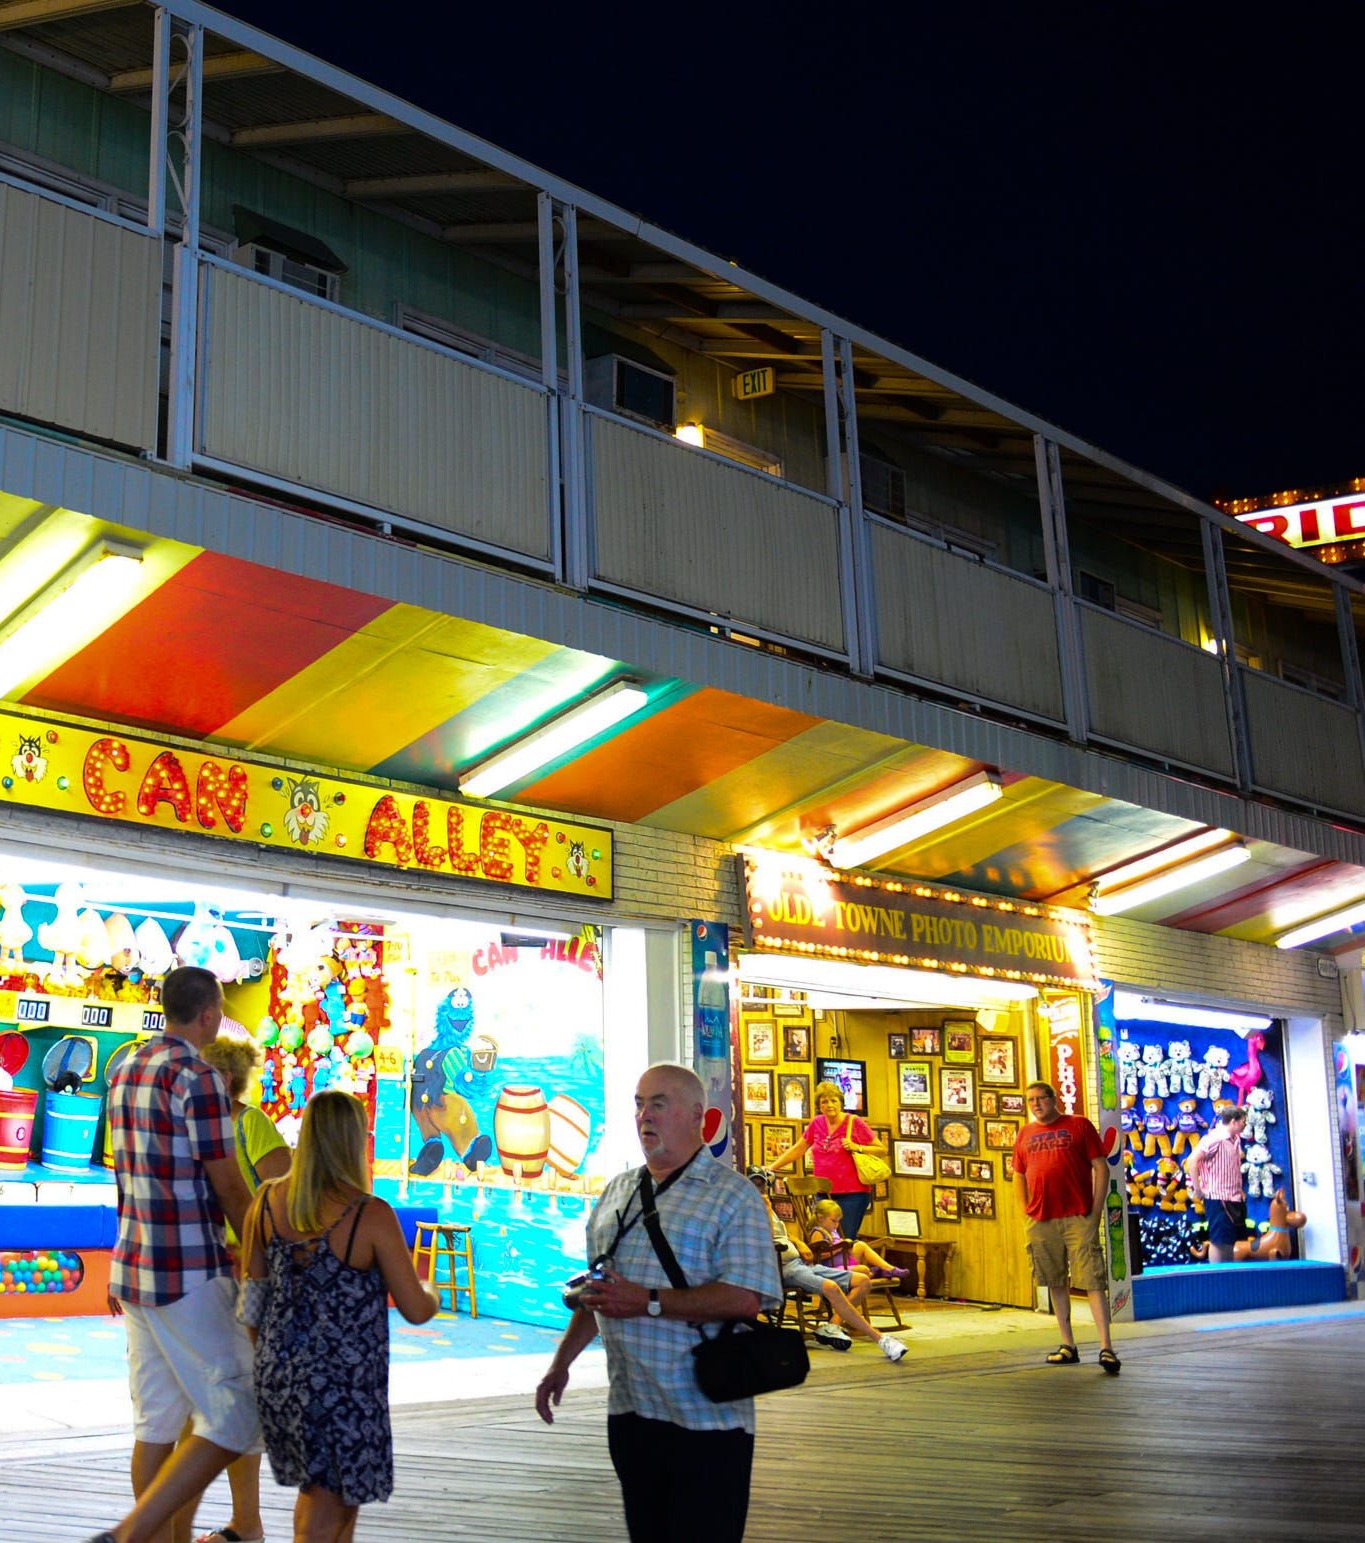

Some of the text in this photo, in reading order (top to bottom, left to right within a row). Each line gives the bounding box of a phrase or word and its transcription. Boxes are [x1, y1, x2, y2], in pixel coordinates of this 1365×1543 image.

[742, 369, 767, 396] EXIT
[82, 737, 550, 883] CAN ALLEY
[835, 899, 907, 939] TOWNE
[910, 913, 978, 950] PHOTO
[540, 938, 594, 973] ALLE
